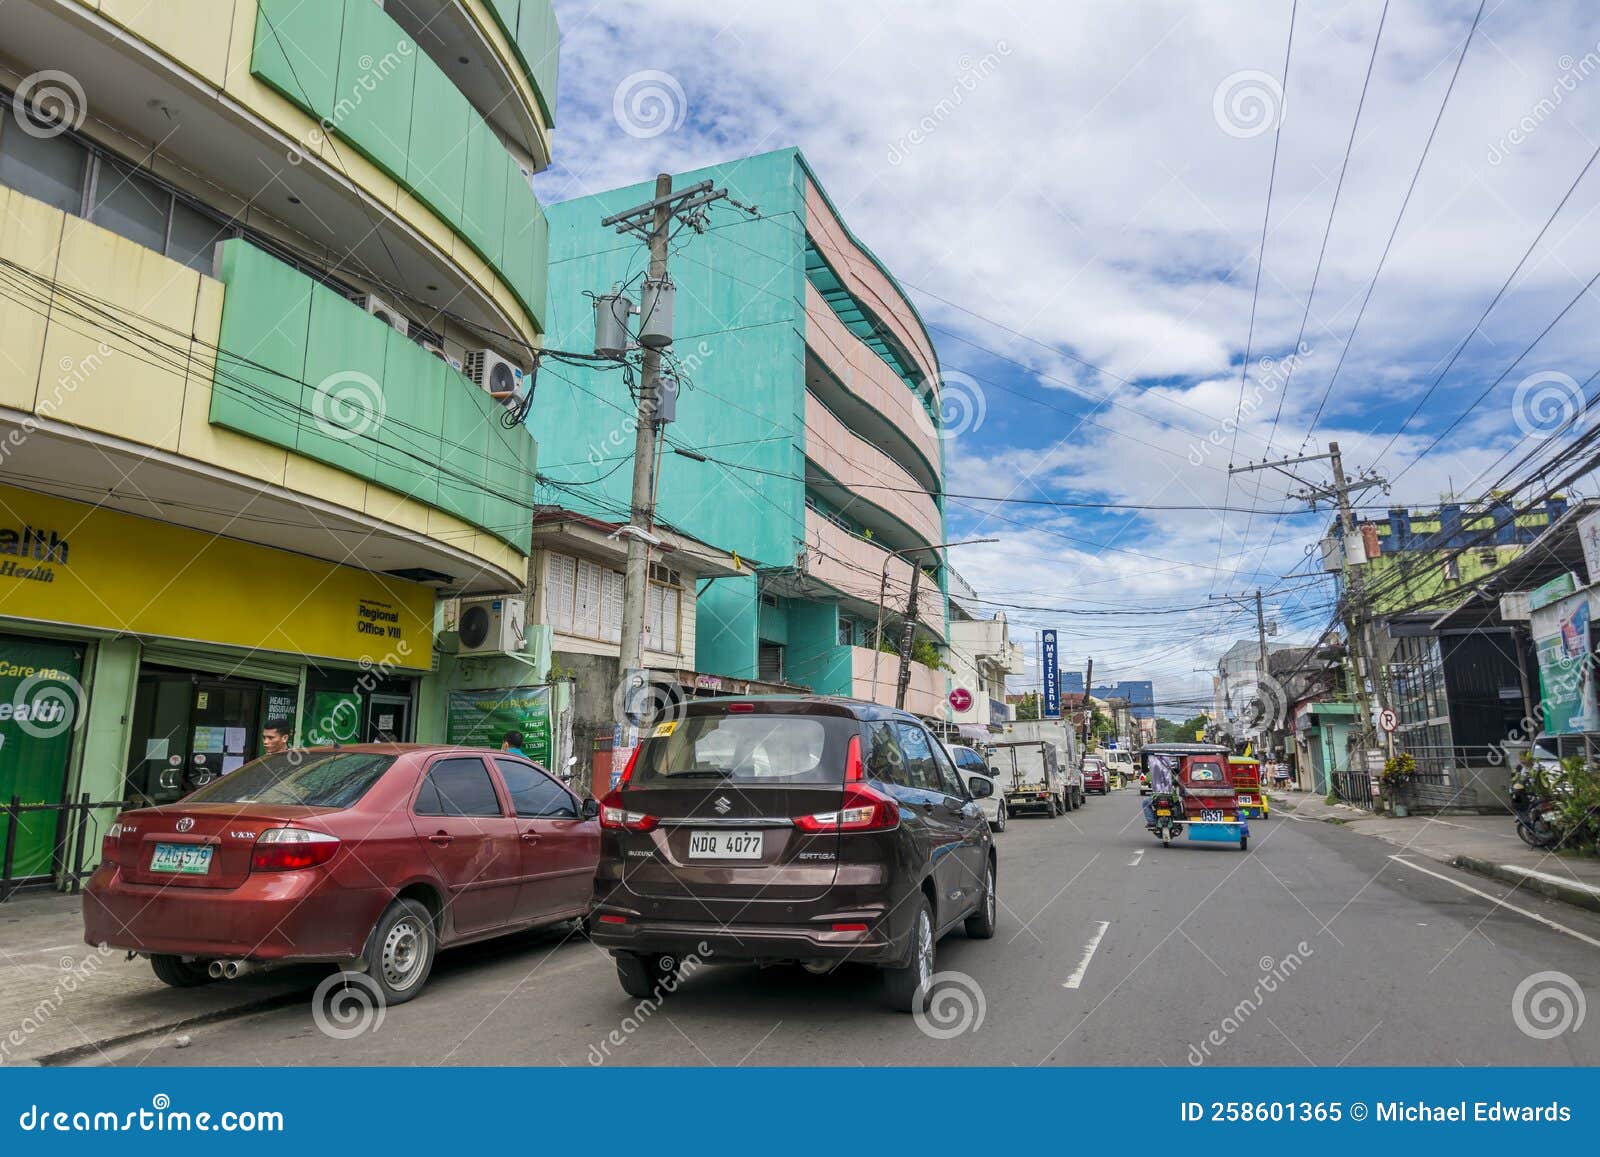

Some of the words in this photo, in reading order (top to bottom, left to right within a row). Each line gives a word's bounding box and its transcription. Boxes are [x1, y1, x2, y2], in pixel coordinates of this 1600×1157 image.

[0, 560, 54, 583] Health
[359, 605, 399, 622] Regional
[358, 621, 385, 636] Office
[388, 626, 401, 639] VIII
[0, 661, 35, 679] Care
[1046, 644, 1055, 710] Metrobank
[269, 695, 291, 706] HEALTH
[1201, 810, 1222, 822] 0537
[691, 836, 716, 853] NDQ
[726, 836, 761, 853] 4077
[157, 846, 179, 862] ZAG
[184, 848, 208, 865] 579
